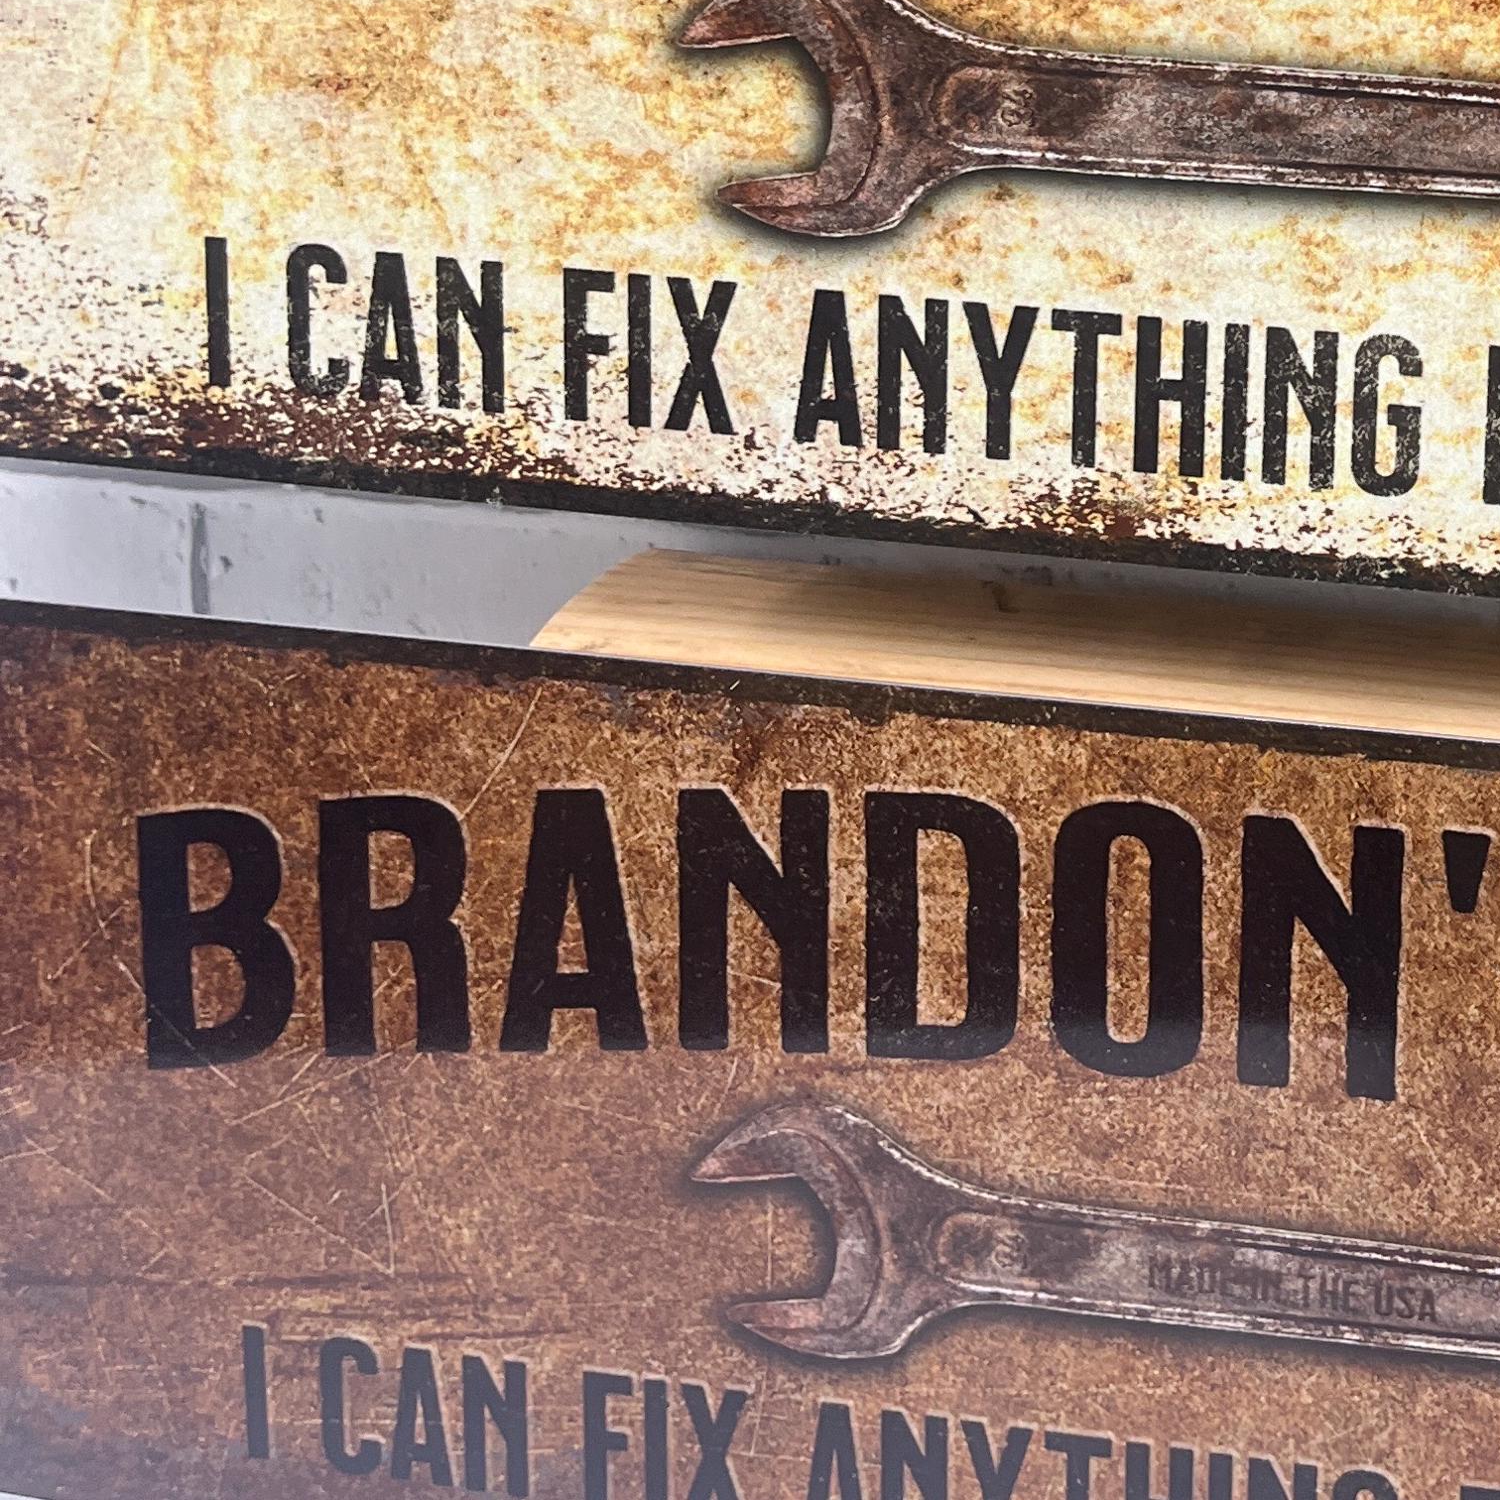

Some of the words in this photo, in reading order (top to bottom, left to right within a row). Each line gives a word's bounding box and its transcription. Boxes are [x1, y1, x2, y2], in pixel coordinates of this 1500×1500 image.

[204, 237, 232, 387] I
[286, 243, 504, 413] CAN
[562, 267, 737, 434] FIX
[794, 290, 1424, 497] ANYTHING
[1373, 1279, 1438, 1323] USA
[243, 1325, 270, 1459] I
[319, 1337, 528, 1498] CAN
[583, 1371, 749, 1500] FIX
